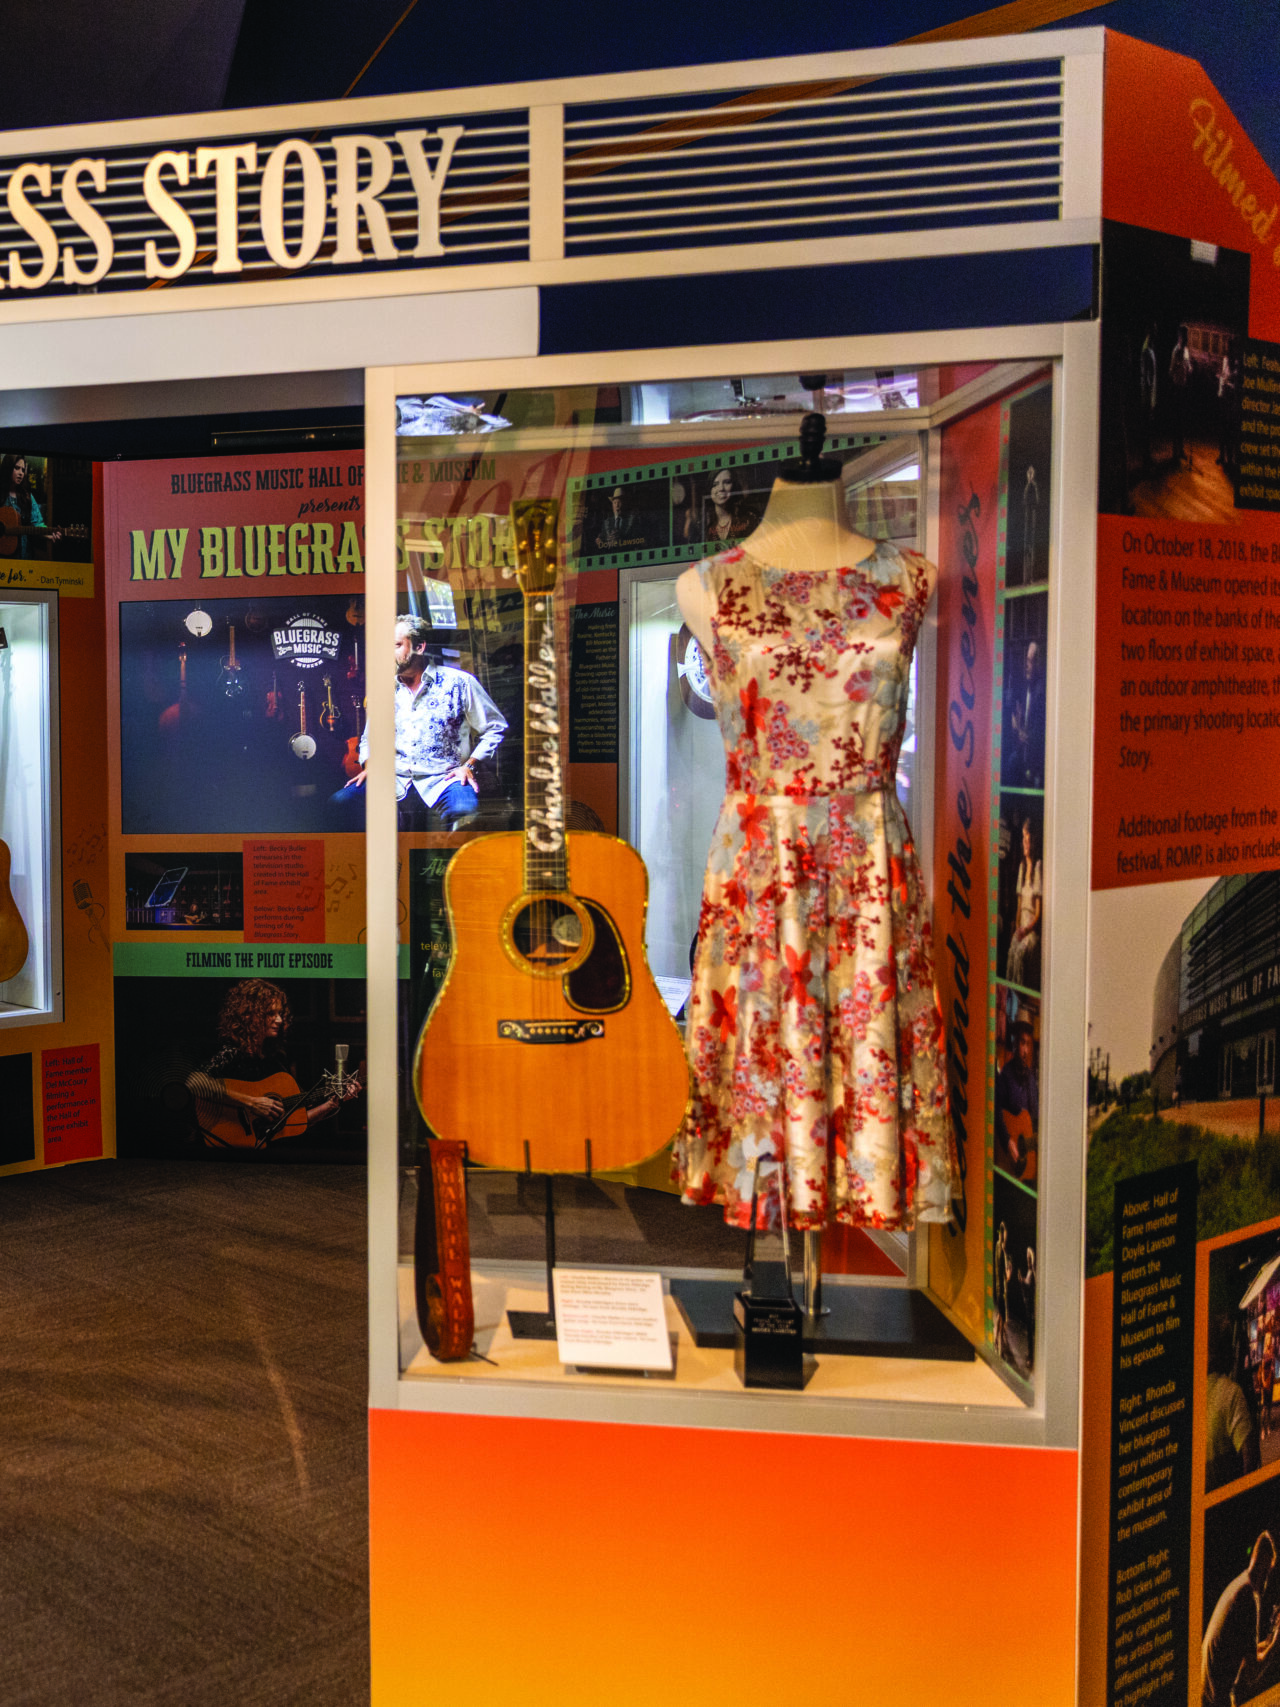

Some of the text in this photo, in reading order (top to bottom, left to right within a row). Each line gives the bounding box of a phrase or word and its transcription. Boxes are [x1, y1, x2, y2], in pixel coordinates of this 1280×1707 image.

[1190, 98, 1279, 244] Filmed
[143, 126, 464, 280] STORY
[171, 470, 251, 495] BLUEGRASS
[255, 467, 304, 490] MUSIC
[308, 466, 342, 489] HALL
[346, 466, 365, 487] OF
[430, 458, 497, 482] MUSEUM
[298, 496, 362, 519] presents
[129, 516, 517, 582] MY BLUEGRAS STOR
[1122, 530, 1269, 563] On October 18, 2018, the
[40, 575, 84, 587] Dan Tyminski
[1122, 567, 1268, 598] Fame & Museum opened
[949, 490, 981, 769] Scenes
[1122, 602, 1171, 626] location
[1174, 610, 1191, 627] on
[1193, 604, 1213, 627] the
[1215, 607, 1249, 628] banks
[1251, 607, 1264, 629] of
[273, 629, 339, 647] BLUEGRASS
[293, 643, 322, 653] MUSIC
[1121, 638, 1276, 666] two floors of exhibit space,
[528, 622, 561, 734] Waller
[1120, 679, 1136, 697] an
[1139, 674, 1189, 697] outdoor
[1120, 709, 1245, 736] the primary shooting
[528, 736, 563, 852] Charlie
[1119, 805, 1278, 838] Additional footage from the
[946, 794, 972, 921] the
[1117, 848, 1163, 873] festival,
[1205, 844, 1215, 864] is
[1217, 841, 1239, 863] also
[186, 952, 333, 969] FILMING THE PILOT EPISODE
